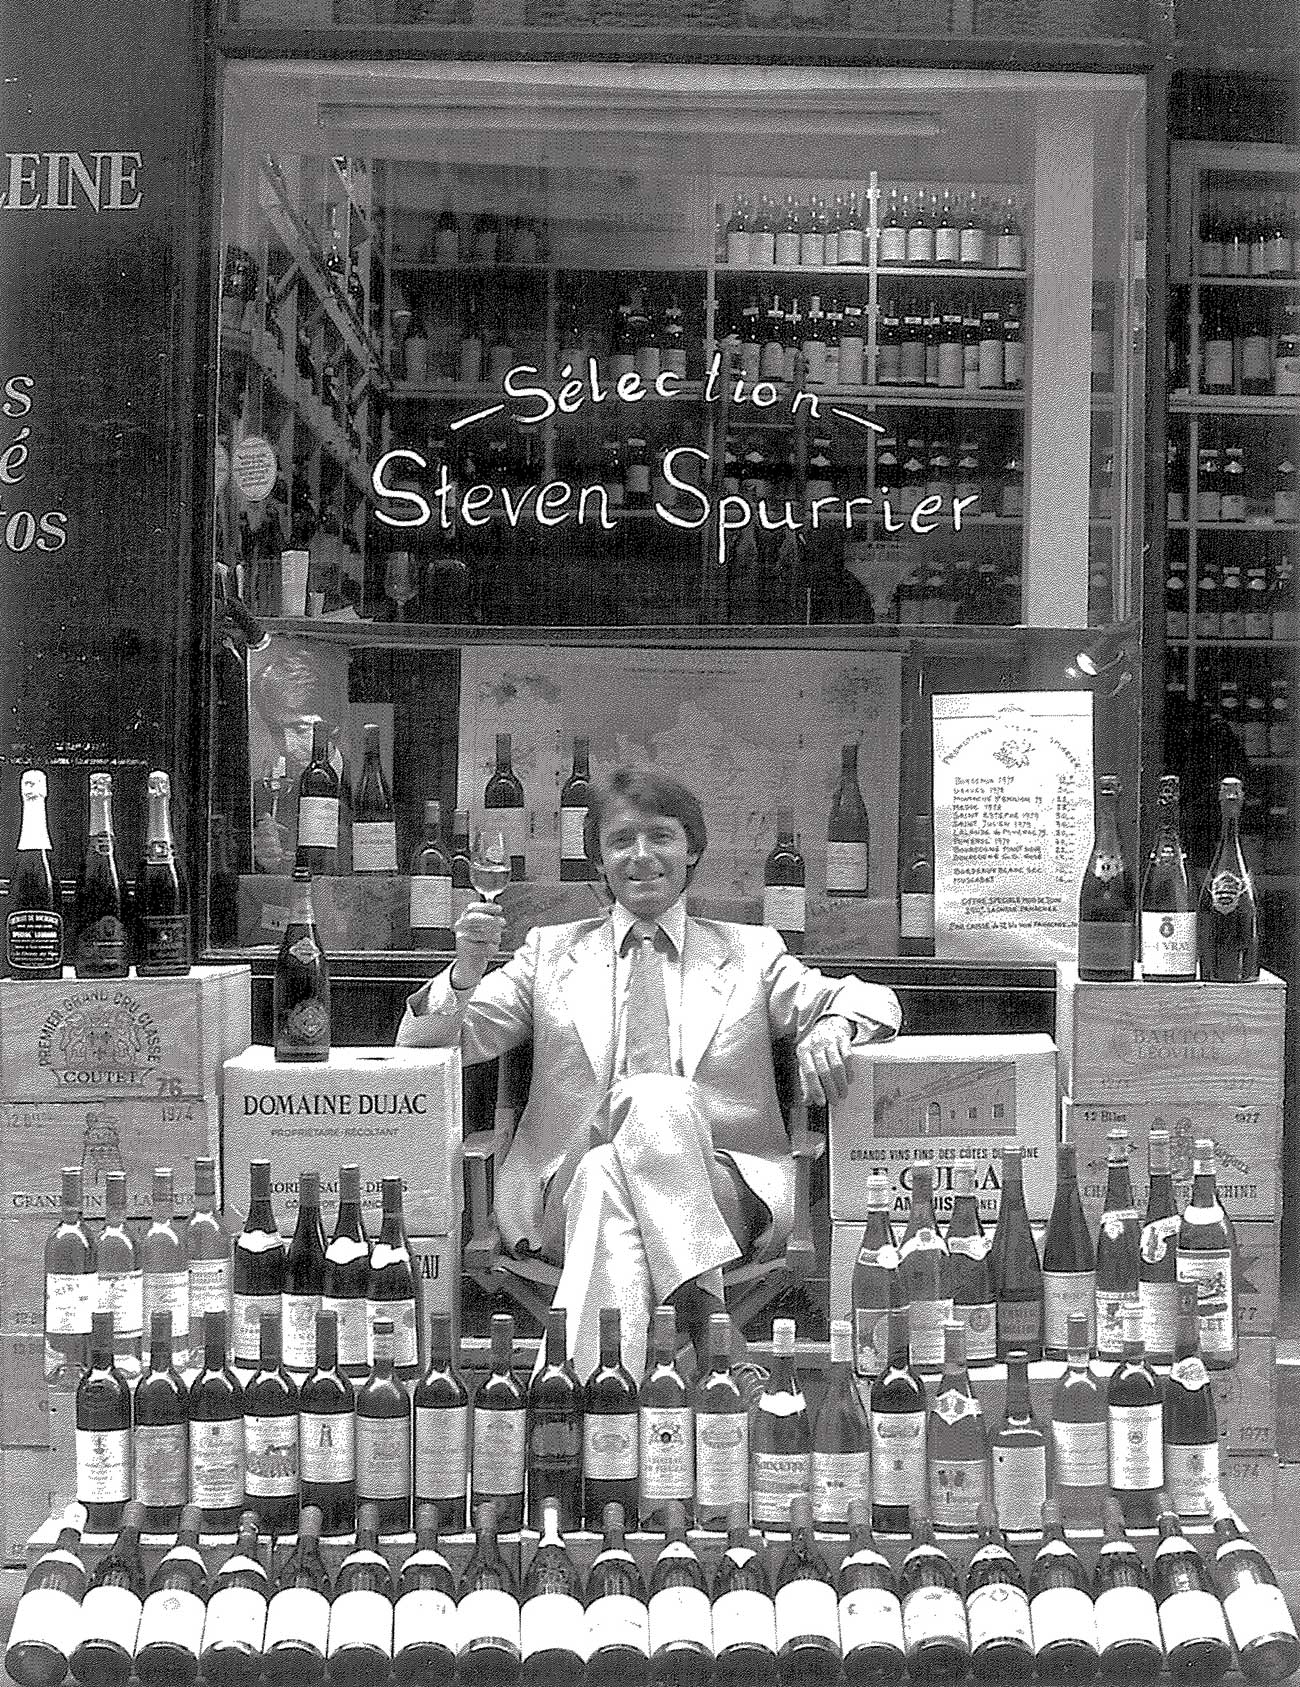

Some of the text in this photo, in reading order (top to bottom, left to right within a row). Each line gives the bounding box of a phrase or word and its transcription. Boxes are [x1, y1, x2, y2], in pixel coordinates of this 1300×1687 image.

[0, 151, 144, 213] EINE
[503, 351, 821, 424] Sélection
[371, 447, 980, 565] Steven Spurrier
[38, 990, 162, 1067] PREMIER GRAND CRU CLASSE
[63, 1070, 138, 1084] COUTET
[243, 1094, 427, 1116] DOMAINE DUJAC
